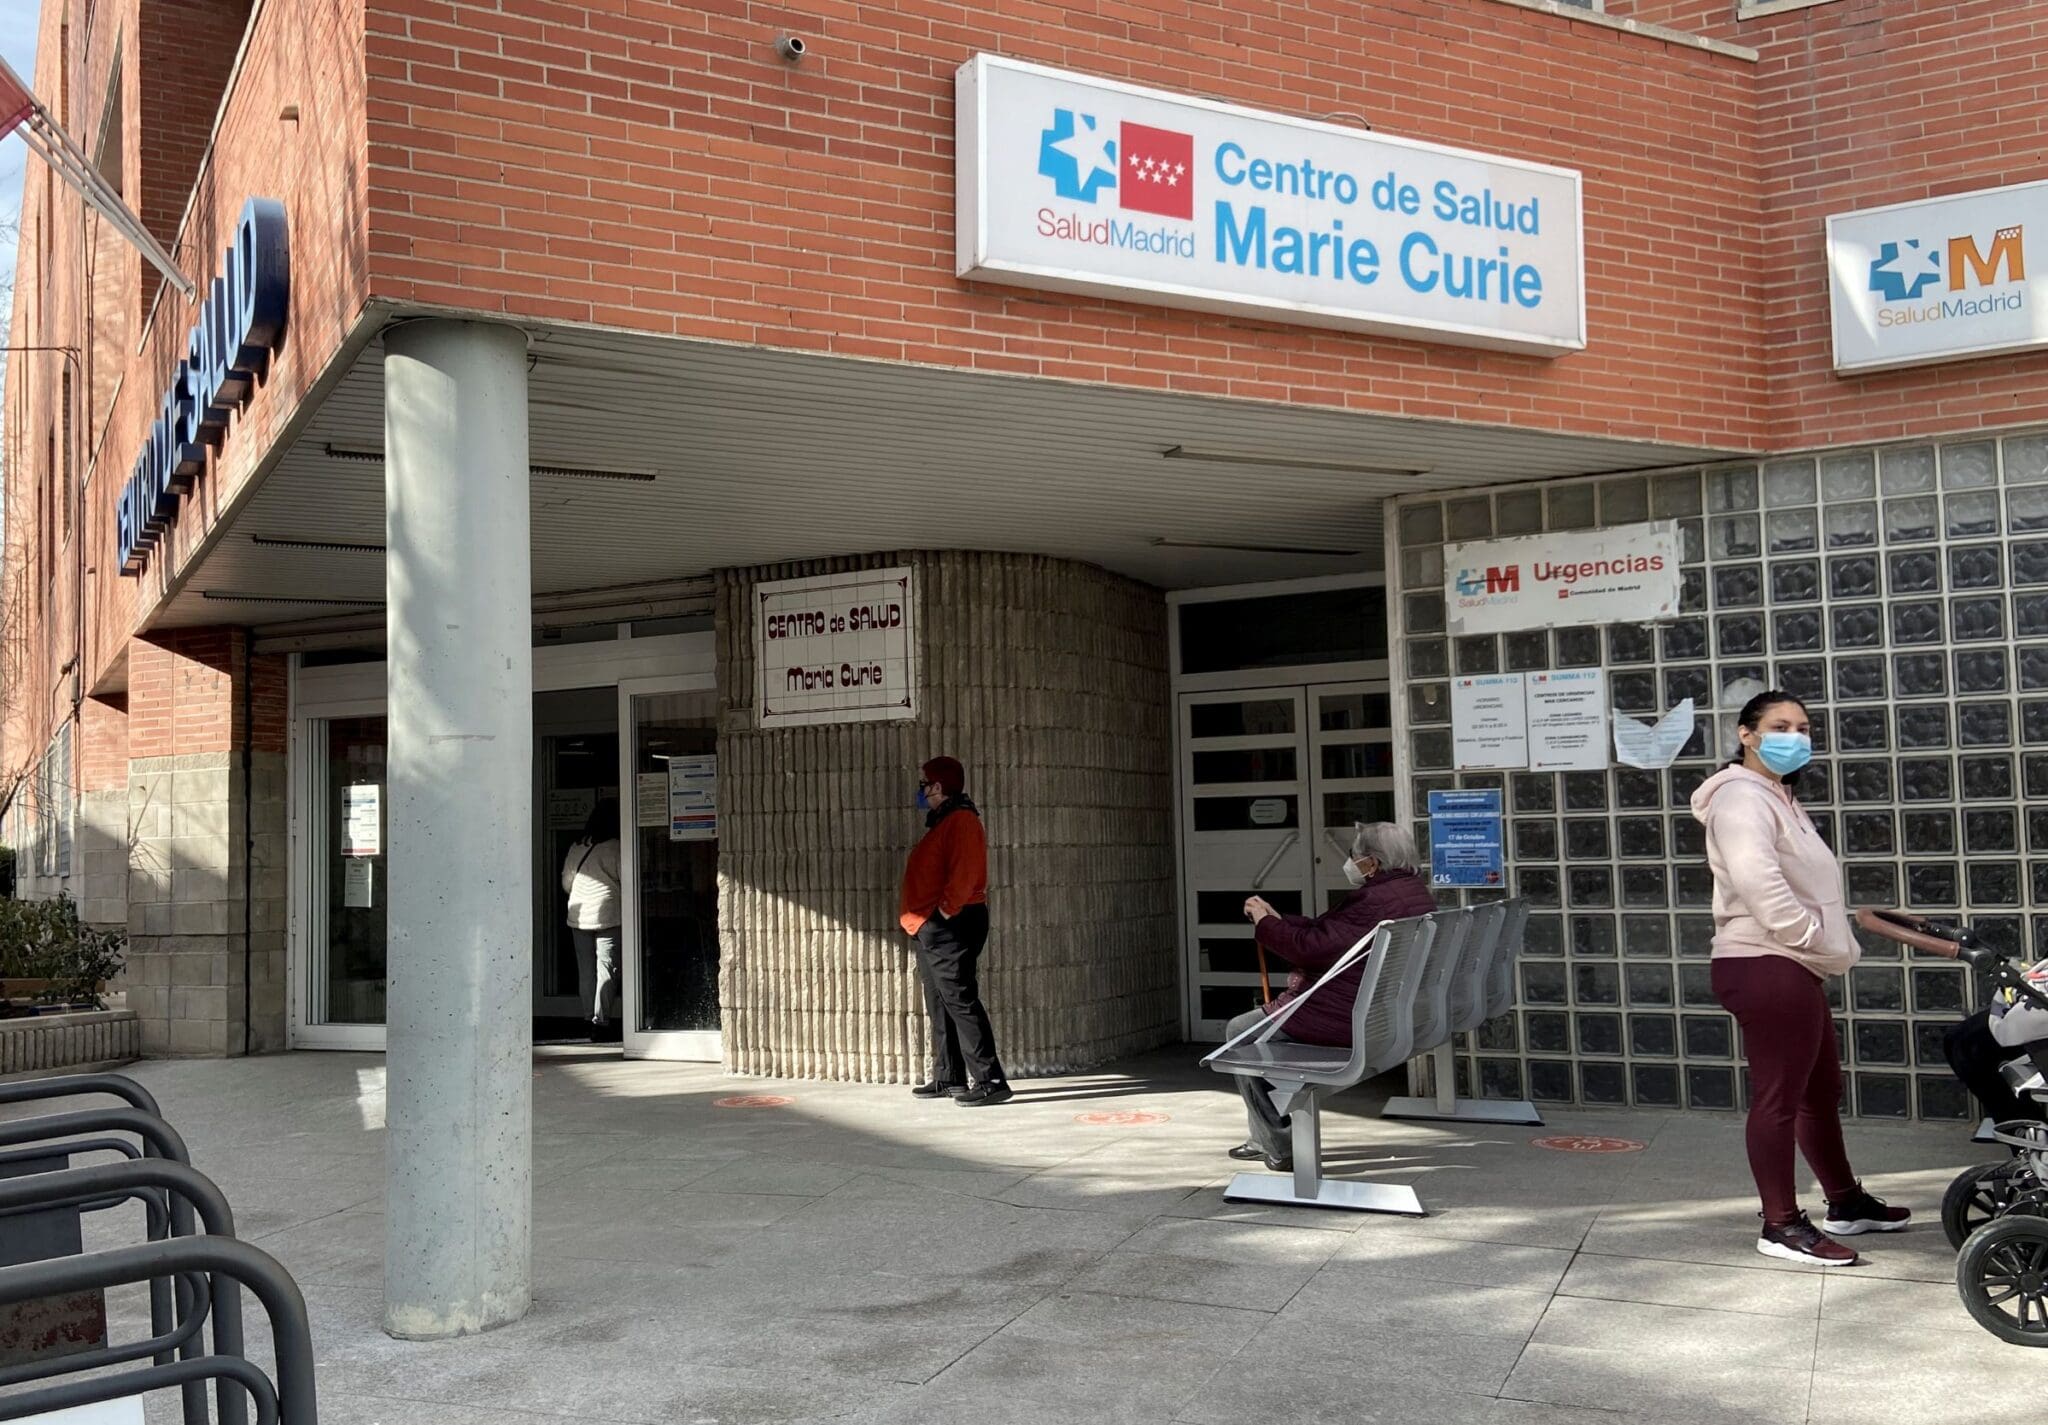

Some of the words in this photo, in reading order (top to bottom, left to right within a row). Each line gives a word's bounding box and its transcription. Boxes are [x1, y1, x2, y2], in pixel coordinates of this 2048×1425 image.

[1215, 142, 1358, 204] Centro
[1372, 172, 1420, 215] de
[1433, 180, 1539, 235] Salud
[1215, 200, 1379, 285] Marie
[1399, 231, 1542, 308] Curie
[187, 195, 276, 446] SALUD
[1533, 554, 1664, 583] Urgencias
[768, 611, 825, 639] CENTRO
[830, 614, 845, 633] de
[850, 604, 901, 630] SALUD
[787, 666, 834, 692] Maria
[840, 661, 883, 687] Curie
[1433, 873, 1452, 884] CAS
